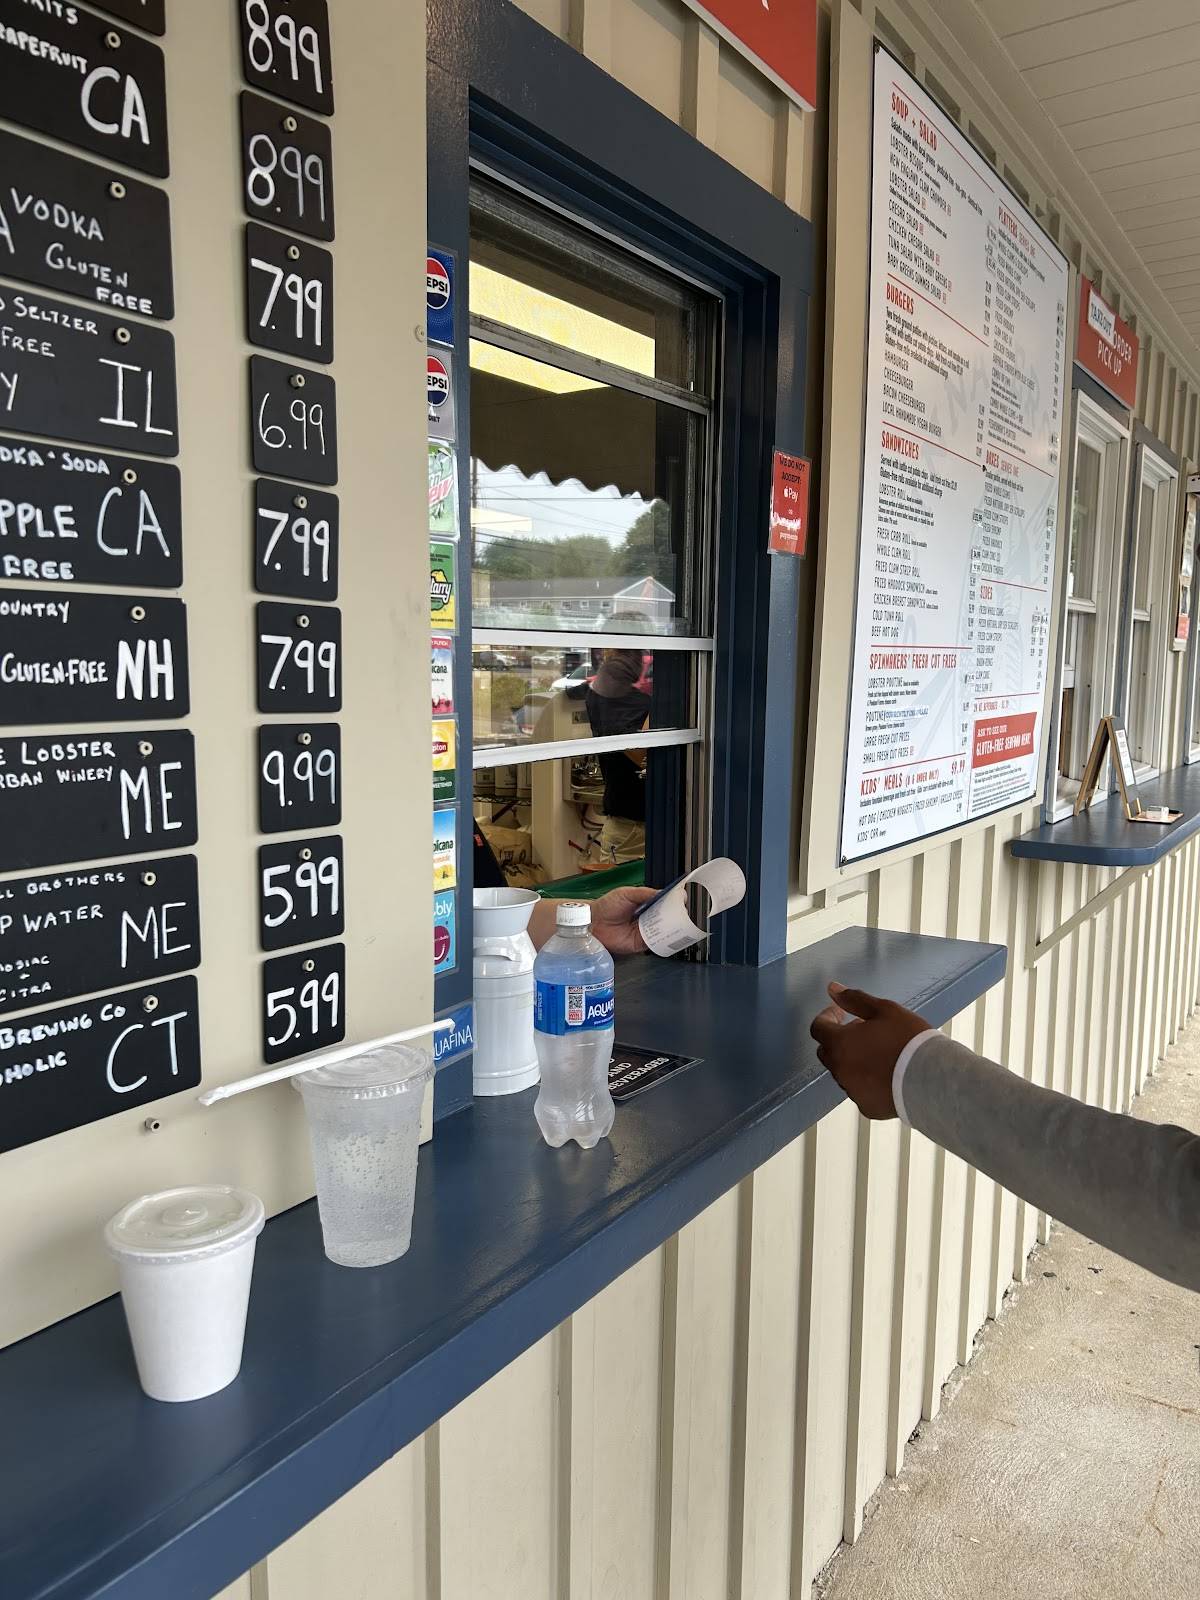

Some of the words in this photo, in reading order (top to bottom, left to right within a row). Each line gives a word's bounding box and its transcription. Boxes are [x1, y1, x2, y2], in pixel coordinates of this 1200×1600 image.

[246, 0, 323, 93] 8.99
[81, 66, 150, 145] CA
[891, 92, 908, 124] SOUP
[919, 120, 936, 152] SALAD
[890, 133, 908, 161] LOBSTER
[247, 134, 325, 222] 8.99
[889, 169, 907, 195] LOBSTER
[11, 187, 104, 241] VODKA
[46, 242, 128, 288] GLUTEN
[96, 286, 153, 315] FREE
[251, 258, 323, 346] 7.99
[886, 282, 914, 316] BURGERS
[1, 326, 55, 357] FREE
[1097, 337, 1112, 370] PICK
[1113, 354, 1121, 379] UP
[1113, 328, 1132, 365] ORDER
[99, 358, 173, 436] IL
[259, 393, 326, 455] 6.99
[62, 452, 110, 475] SODA
[881, 431, 919, 460] SANDWICHES
[97, 486, 170, 557] CA
[258, 507, 329, 582] 7.99
[3, 554, 74, 580] FREE
[116, 639, 175, 701] NH
[260, 635, 337, 698] 7.99
[911, 654, 928, 669] FRESH
[930, 654, 940, 668] CUT
[942, 654, 956, 668] FRIES
[22, 741, 116, 765] LOBSTER
[262, 750, 336, 807] 9.99
[120, 761, 182, 840] ME
[883, 772, 902, 790] MEALS
[27, 872, 126, 895] BROTHERS
[263, 856, 339, 928] 5.99
[23, 904, 104, 934] WATER
[121, 902, 191, 968] ME
[0, 1013, 93, 1049] BREWING
[266, 971, 340, 1046] 5.99
[106, 1011, 188, 1093] CT
